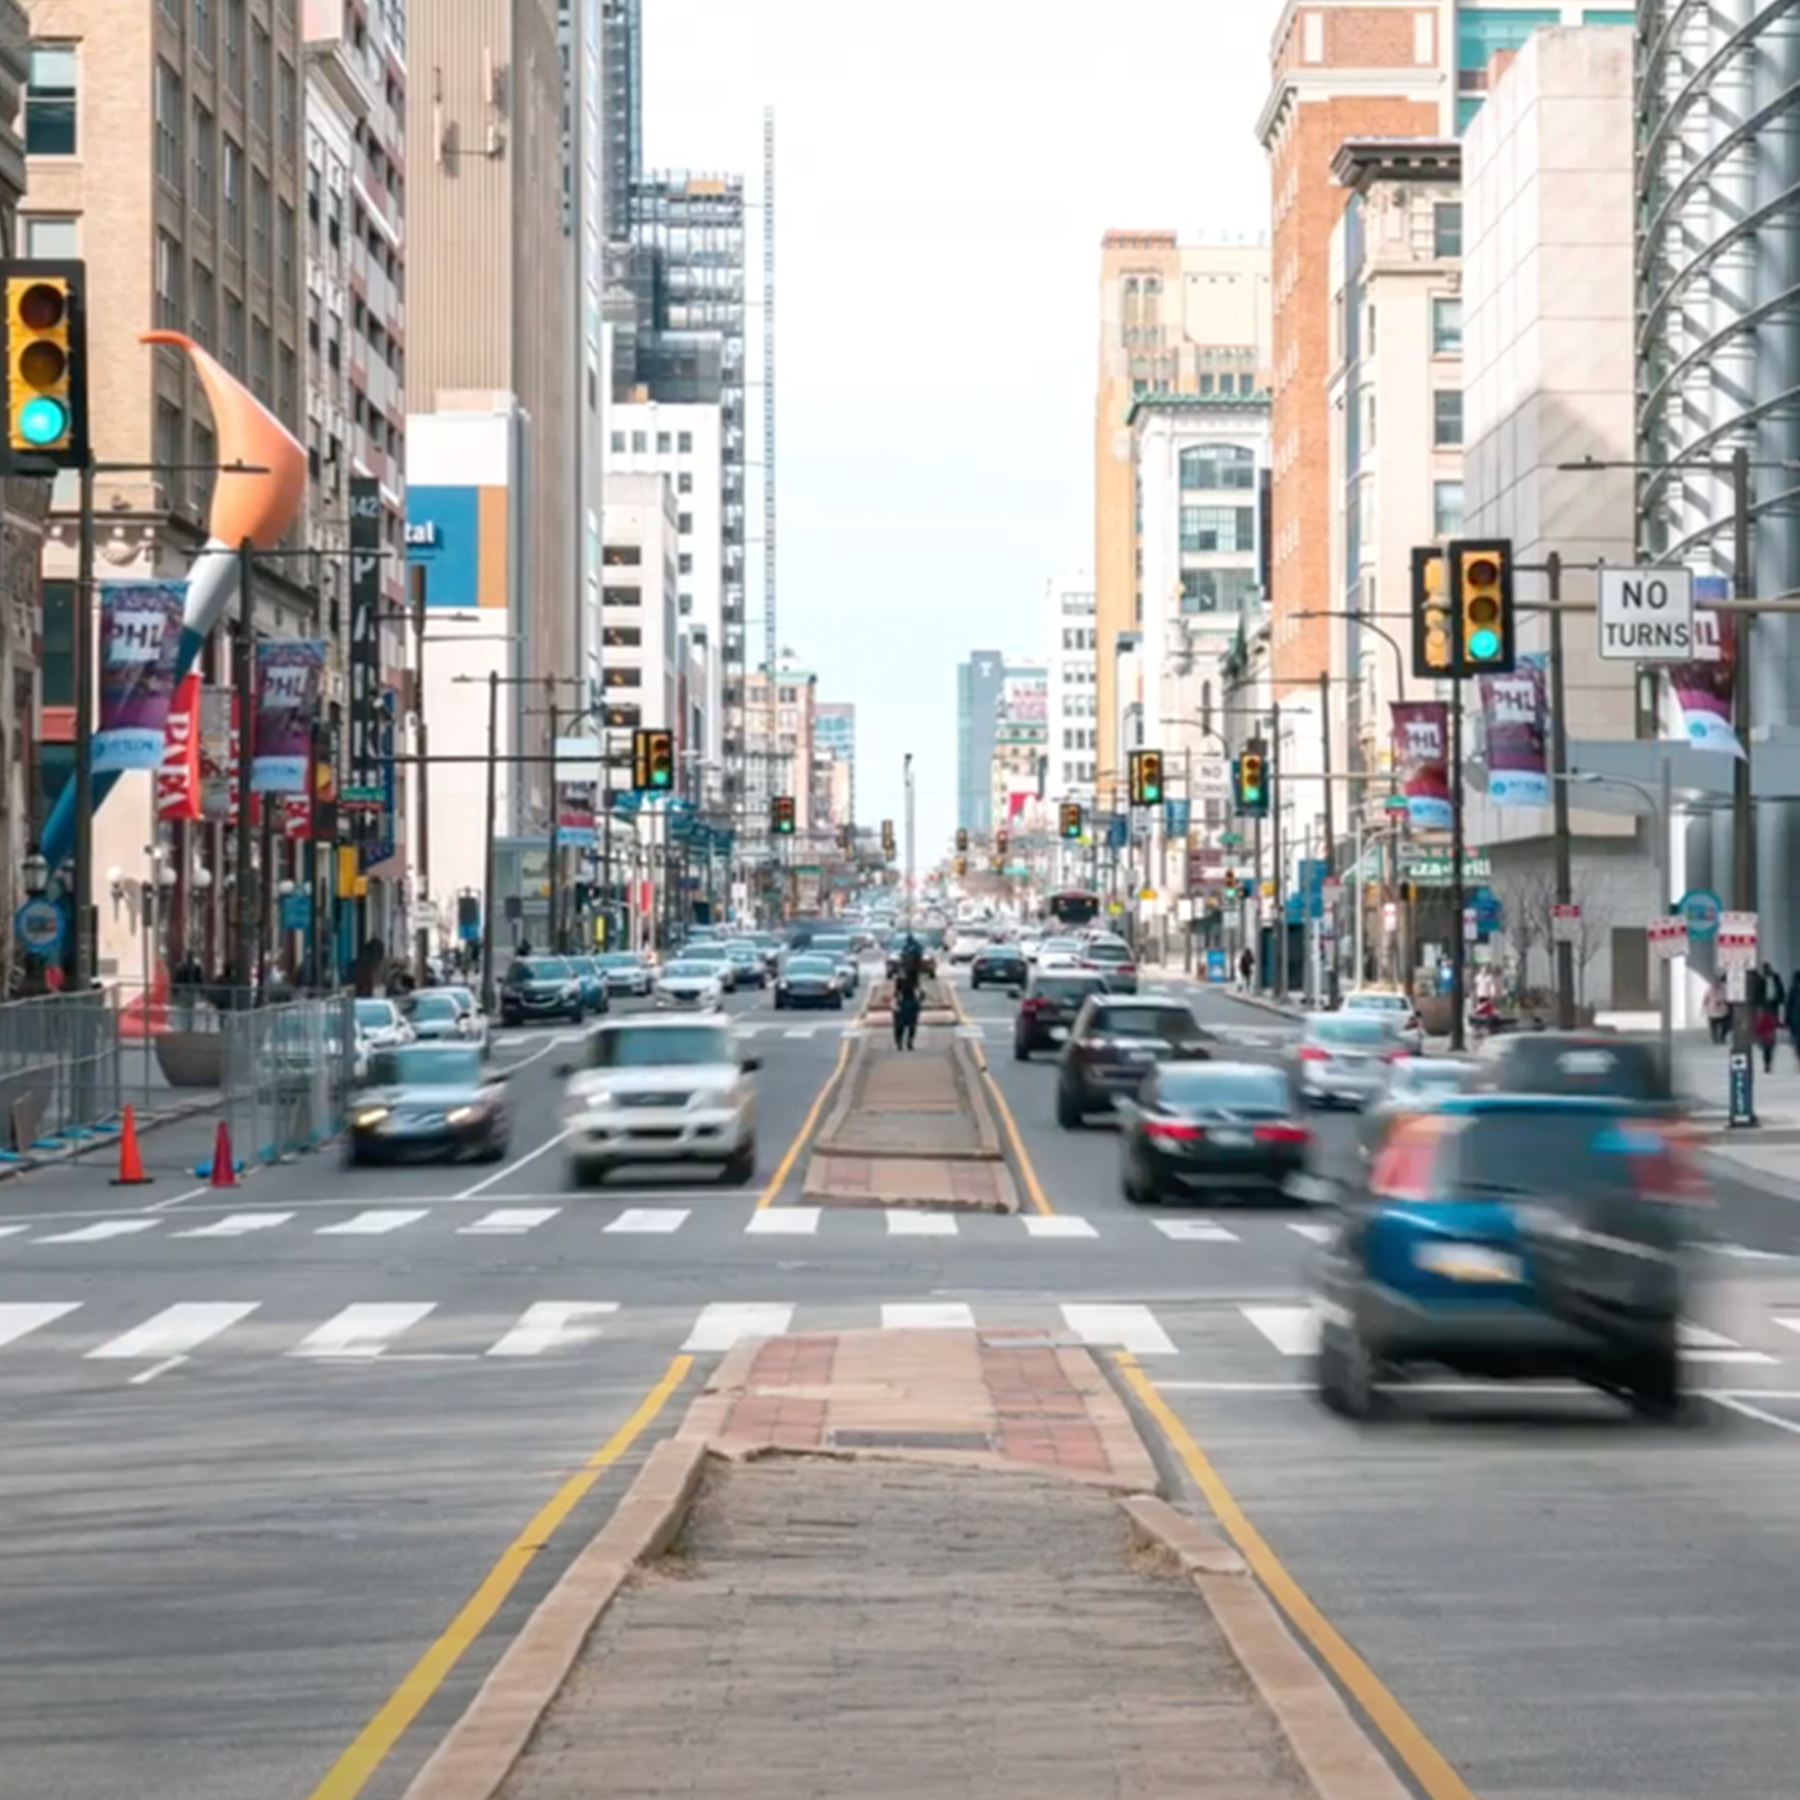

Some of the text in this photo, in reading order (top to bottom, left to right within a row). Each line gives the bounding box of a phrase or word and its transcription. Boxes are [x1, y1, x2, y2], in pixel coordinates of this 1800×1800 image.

[1622, 580, 1668, 609] NO
[111, 622, 162, 649] PHL
[1605, 622, 1690, 647] TURNS
[1494, 689, 1535, 711] PHL
[1201, 766, 1222, 779] NO
